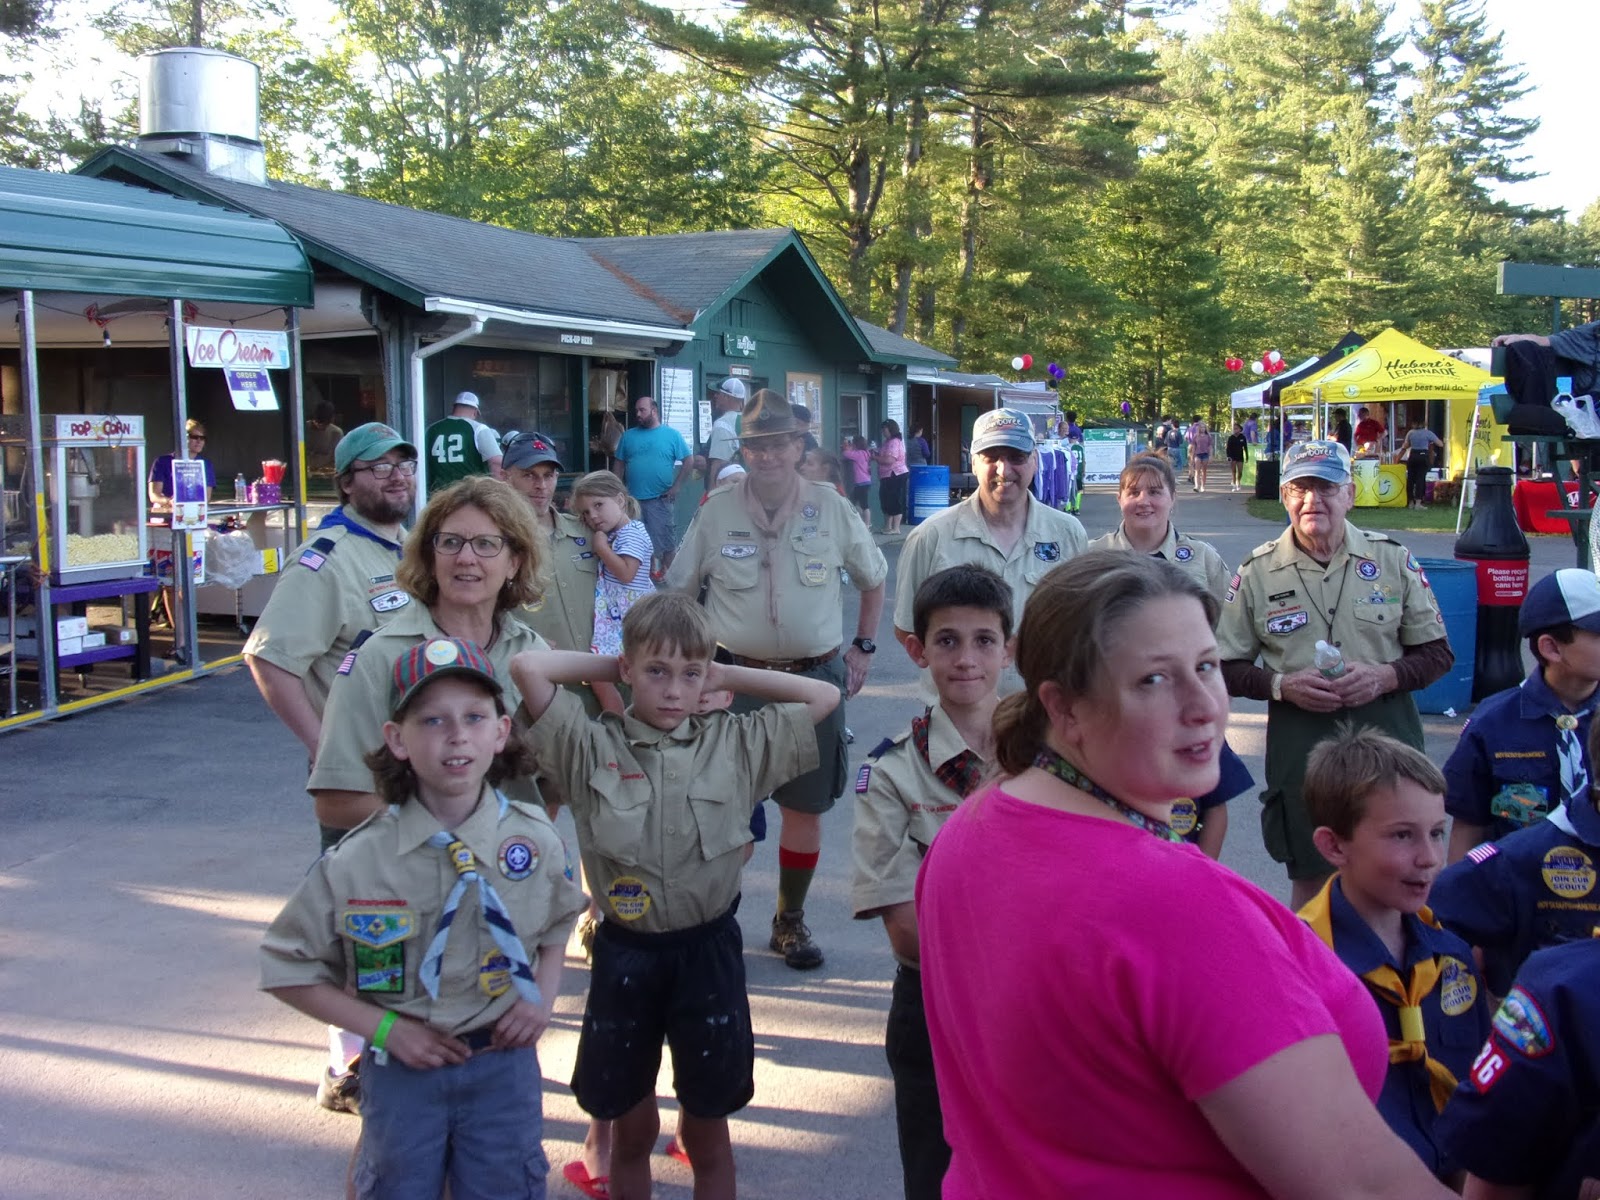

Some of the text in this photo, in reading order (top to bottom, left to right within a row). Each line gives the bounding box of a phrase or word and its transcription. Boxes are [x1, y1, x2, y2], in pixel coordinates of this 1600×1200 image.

[560, 334, 580, 344] PICK-UP
[191, 328, 274, 366] Ice Cream
[1384, 358, 1454, 371] Hubert's
[1387, 367, 1457, 380] LEMONADE
[1398, 384, 1413, 392] the
[1414, 382, 1432, 391] best
[70, 420, 131, 436] POP CORN
[431, 433, 464, 463] 42
[1294, 448, 1334, 461] Jamboree
[1553, 883, 1587, 891] SCOUTS
[1452, 984, 1471, 997] CUB
